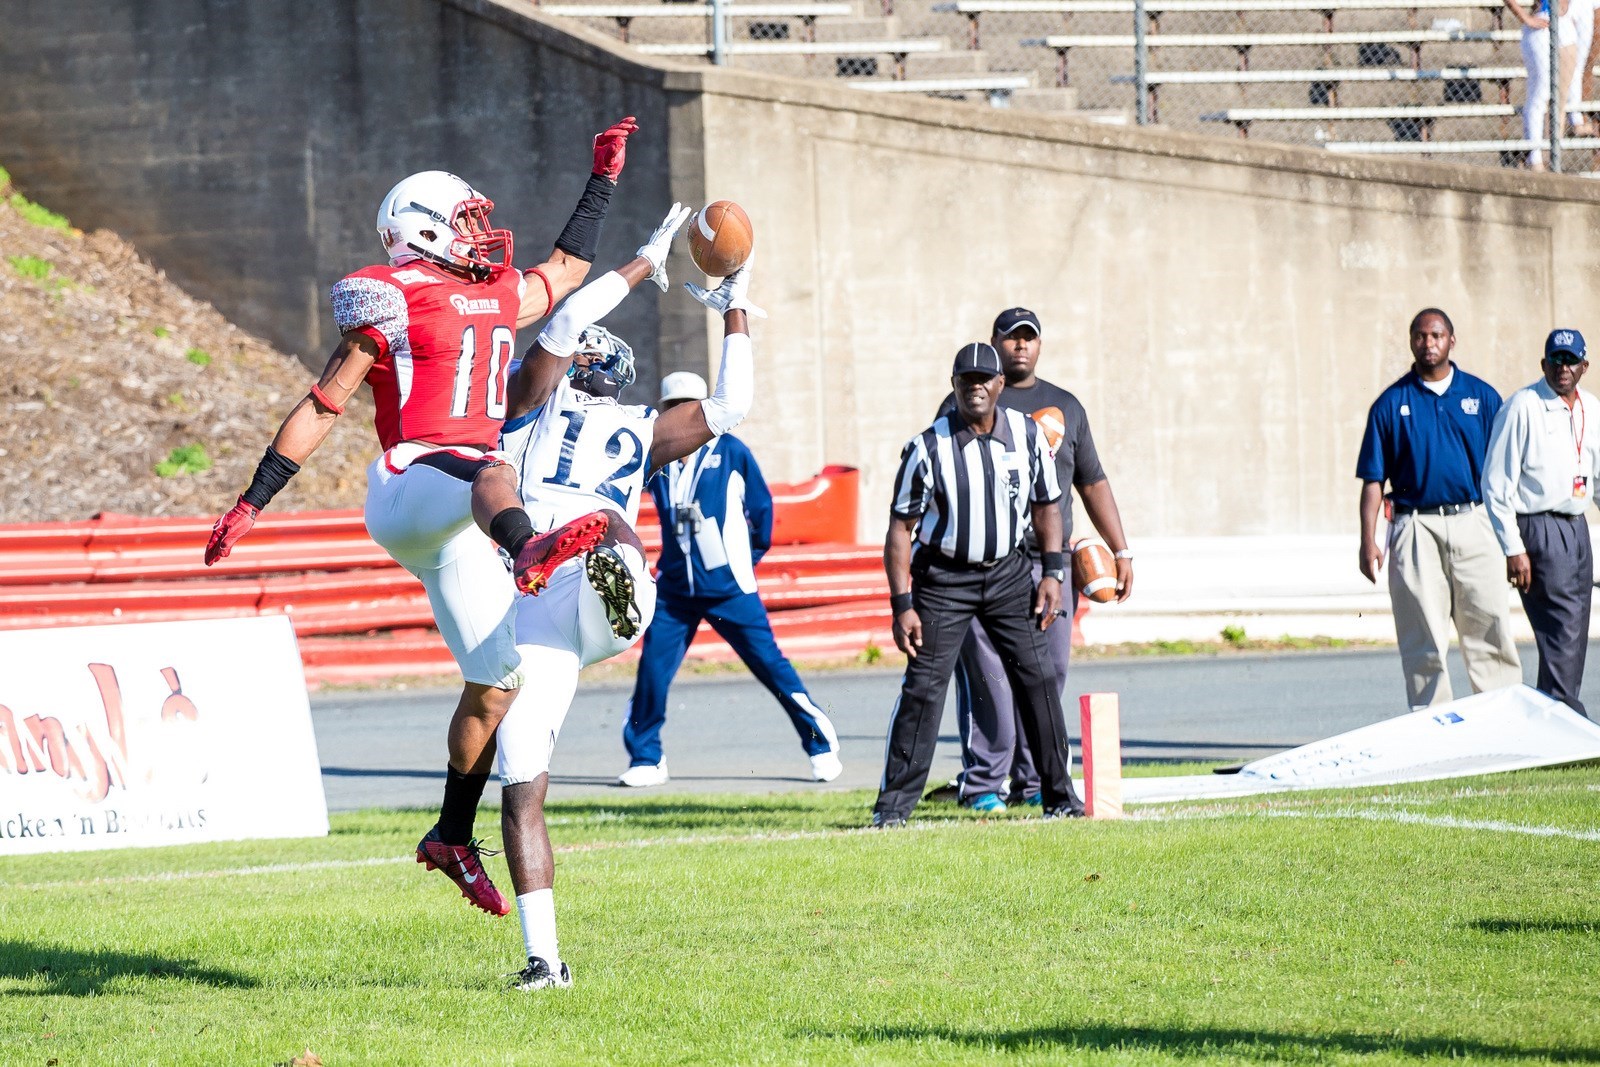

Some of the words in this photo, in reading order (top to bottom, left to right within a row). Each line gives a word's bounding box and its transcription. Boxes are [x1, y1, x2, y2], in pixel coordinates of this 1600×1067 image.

[449, 293, 501, 315] Rams
[450, 324, 515, 420] 10
[543, 409, 643, 512] 12
